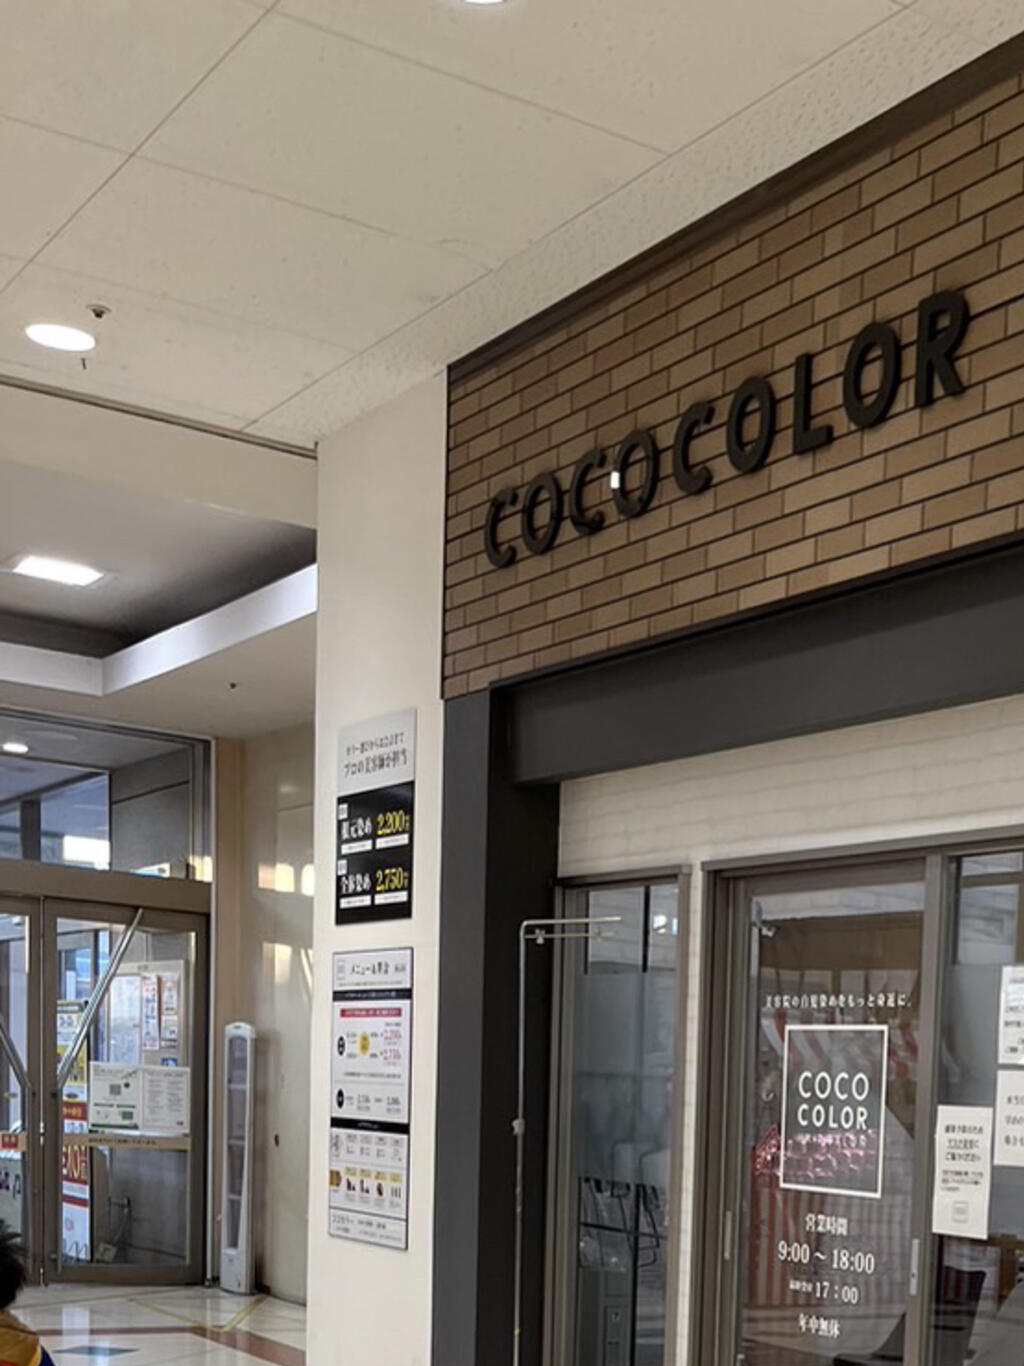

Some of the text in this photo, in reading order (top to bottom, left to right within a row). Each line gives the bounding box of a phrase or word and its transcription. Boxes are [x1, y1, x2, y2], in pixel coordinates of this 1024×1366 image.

[484, 287, 970, 569] COCOCOLOR
[798, 1071, 869, 1101] COCO
[797, 1103, 868, 1130] COLOR
[805, 1213, 848, 1236] 営業時間
[799, 1313, 840, 1339] 年中無休
